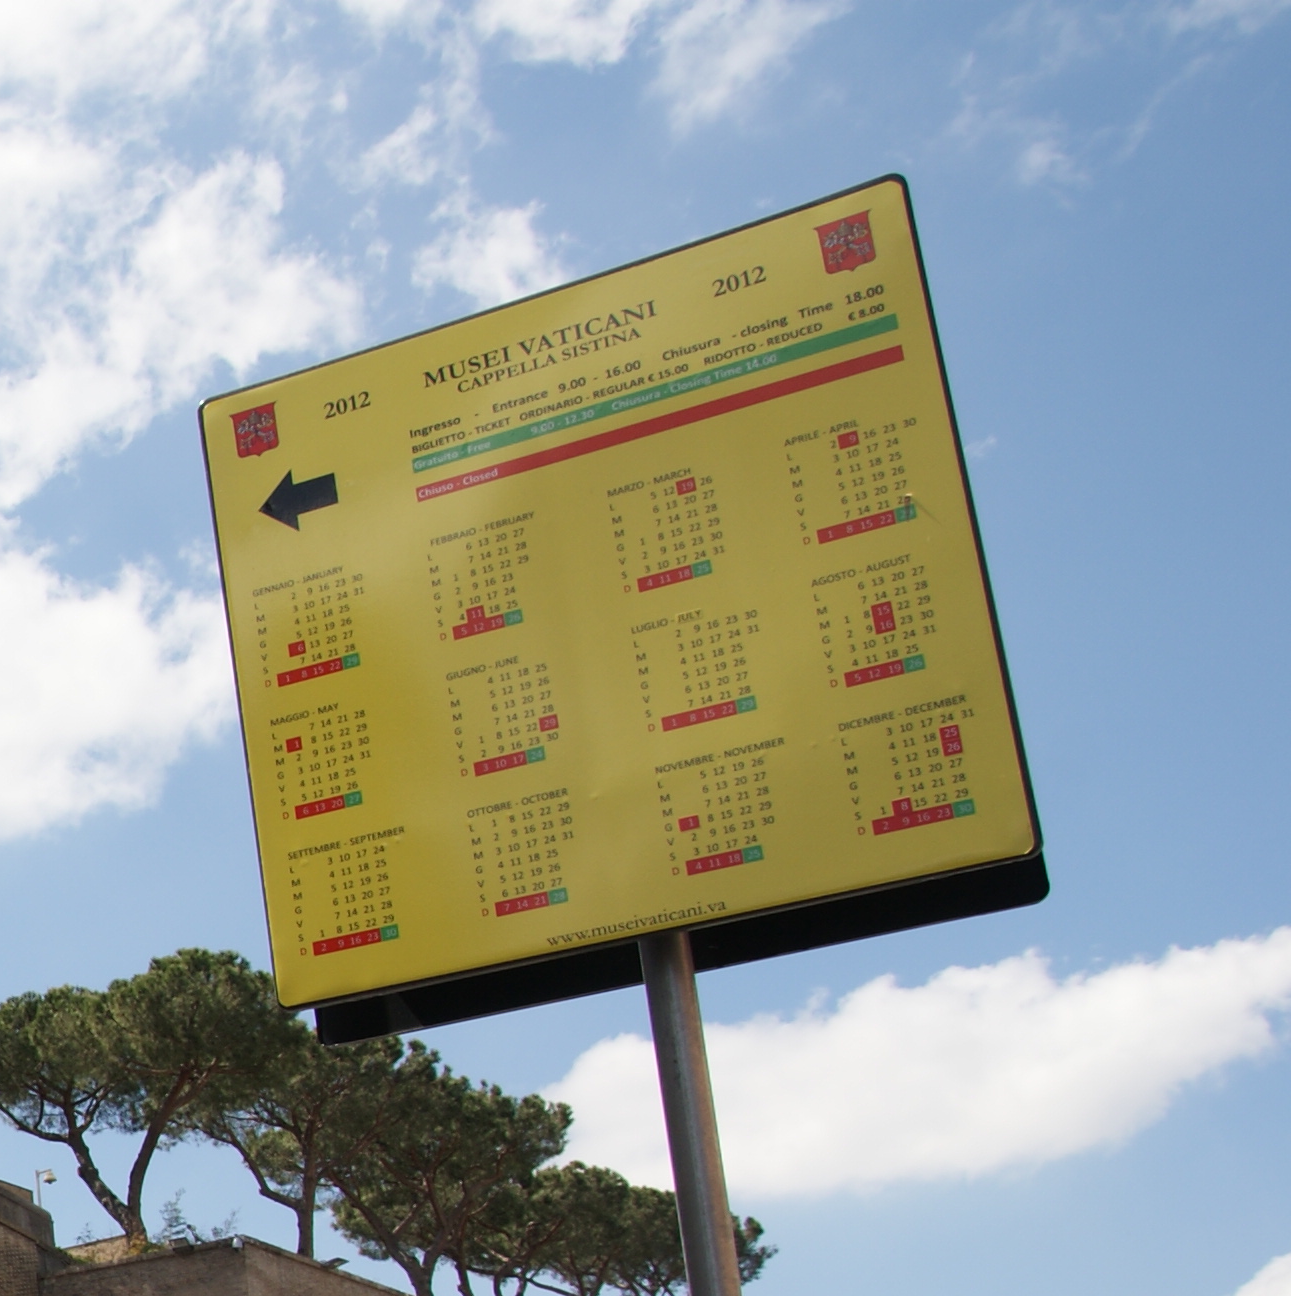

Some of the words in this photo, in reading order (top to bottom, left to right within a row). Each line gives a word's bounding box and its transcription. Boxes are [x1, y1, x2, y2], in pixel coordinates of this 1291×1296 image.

[712, 265, 767, 297] 2012
[423, 346, 509, 388] MUSEI
[517, 299, 656, 355] VATICANI
[408, 416, 461, 438] Ingresso
[491, 390, 548, 413] Entrance
[557, 376, 586, 393] 9.00
[605, 359, 641, 379] 16.00
[661, 337, 721, 361] Chiusura
[739, 316, 788, 338] closing
[797, 302, 833, 319] Time
[845, 284, 884, 305] 18.00
[456, 354, 556, 393] CAPPELLA
[561, 327, 641, 361] SISTINA
[411, 430, 466, 454] BIGLIETTO
[474, 416, 510, 434] TICKET
[518, 395, 583, 421] ORDINARIO
[592, 376, 645, 399] REGULAR
[647, 373, 655, 382] €
[658, 363, 689, 380] 15.00
[703, 342, 756, 365] RIDOTTO
[766, 322, 823, 346] REDUCED
[847, 311, 856, 321] €
[858, 302, 885, 318] 8.00
[323, 390, 371, 419] 2012
[413, 451, 459, 469] Gratuito
[467, 441, 491, 454] Free
[530, 421, 554, 434] 9.00
[564, 409, 594, 425] 12.30
[610, 391, 661, 411] Chiusura
[667, 375, 711, 393] Closing
[713, 366, 742, 380] Time
[745, 354, 777, 370] 14.00
[784, 430, 818, 447] APRILE
[829, 419, 858, 434] APRIL
[417, 482, 454, 498] Chiuso
[462, 468, 498, 485] Closed
[606, 480, 644, 497] MARZO
[652, 467, 691, 484] MARCH
[854, 490, 868, 501] 13
[874, 485, 888, 496] 20
[894, 479, 907, 491] 27
[429, 527, 477, 546] FEBBRAIO
[484, 511, 534, 530] FEBRUARY
[657, 559, 669, 570] 10
[675, 554, 687, 565] 17
[694, 549, 706, 560] 24
[713, 545, 725, 555] 31
[811, 568, 856, 587] AGOSTO
[865, 553, 910, 573] AUGUST
[252, 579, 295, 597] GENNAIO
[302, 566, 343, 583] JANUARY
[469, 595, 481, 605] 10
[486, 590, 498, 601] 17
[504, 585, 516, 596] 24
[630, 617, 668, 634] LUGLIO
[677, 609, 701, 623] JULY
[862, 639, 876, 650] 10
[882, 633, 895, 645] 17
[902, 629, 916, 640] 24
[922, 624, 936, 635] 31
[311, 652, 322, 662] 14
[327, 647, 338, 658] 21
[344, 643, 356, 653] 28
[445, 664, 486, 680] GIUGNO
[495, 655, 518, 668] JUNE
[697, 680, 710, 691] 13
[717, 675, 729, 686] 20
[735, 670, 748, 682] 27
[504, 698, 516, 709] 13
[522, 694, 534, 705] 20
[539, 689, 551, 701] 27
[838, 711, 894, 731] DICEMBRE
[904, 694, 966, 716] DECEMBER
[269, 710, 309, 726] MAGGIO
[317, 702, 338, 714] MAY
[899, 722, 913, 733] 10
[920, 716, 933, 728] 17
[940, 712, 954, 724] 24
[960, 708, 974, 719] 31
[309, 762, 321, 772] 10
[326, 757, 337, 768] 17
[343, 753, 354, 764] 24
[360, 749, 371, 759] 31
[654, 753, 714, 773] NOVEMBRE
[723, 737, 784, 758] NOVEMBER
[908, 766, 922, 778] 13
[928, 762, 943, 773] 20
[949, 757, 962, 768] 27
[715, 780, 728, 791] 13
[734, 775, 748, 786] 20
[753, 770, 766, 782] 27
[466, 800, 512, 818] OTTOBRE
[520, 787, 568, 806] OCTOBER
[287, 841, 340, 860] SETTEMBRE
[349, 826, 405, 846] SEPTEMBER
[344, 893, 356, 904] 13
[361, 889, 373, 900] 20
[378, 885, 390, 896] 27
[514, 884, 526, 895] 13
[532, 881, 545, 891] 20
[550, 876, 563, 887] 27
[546, 901, 727, 946] www.museivaticani.va
